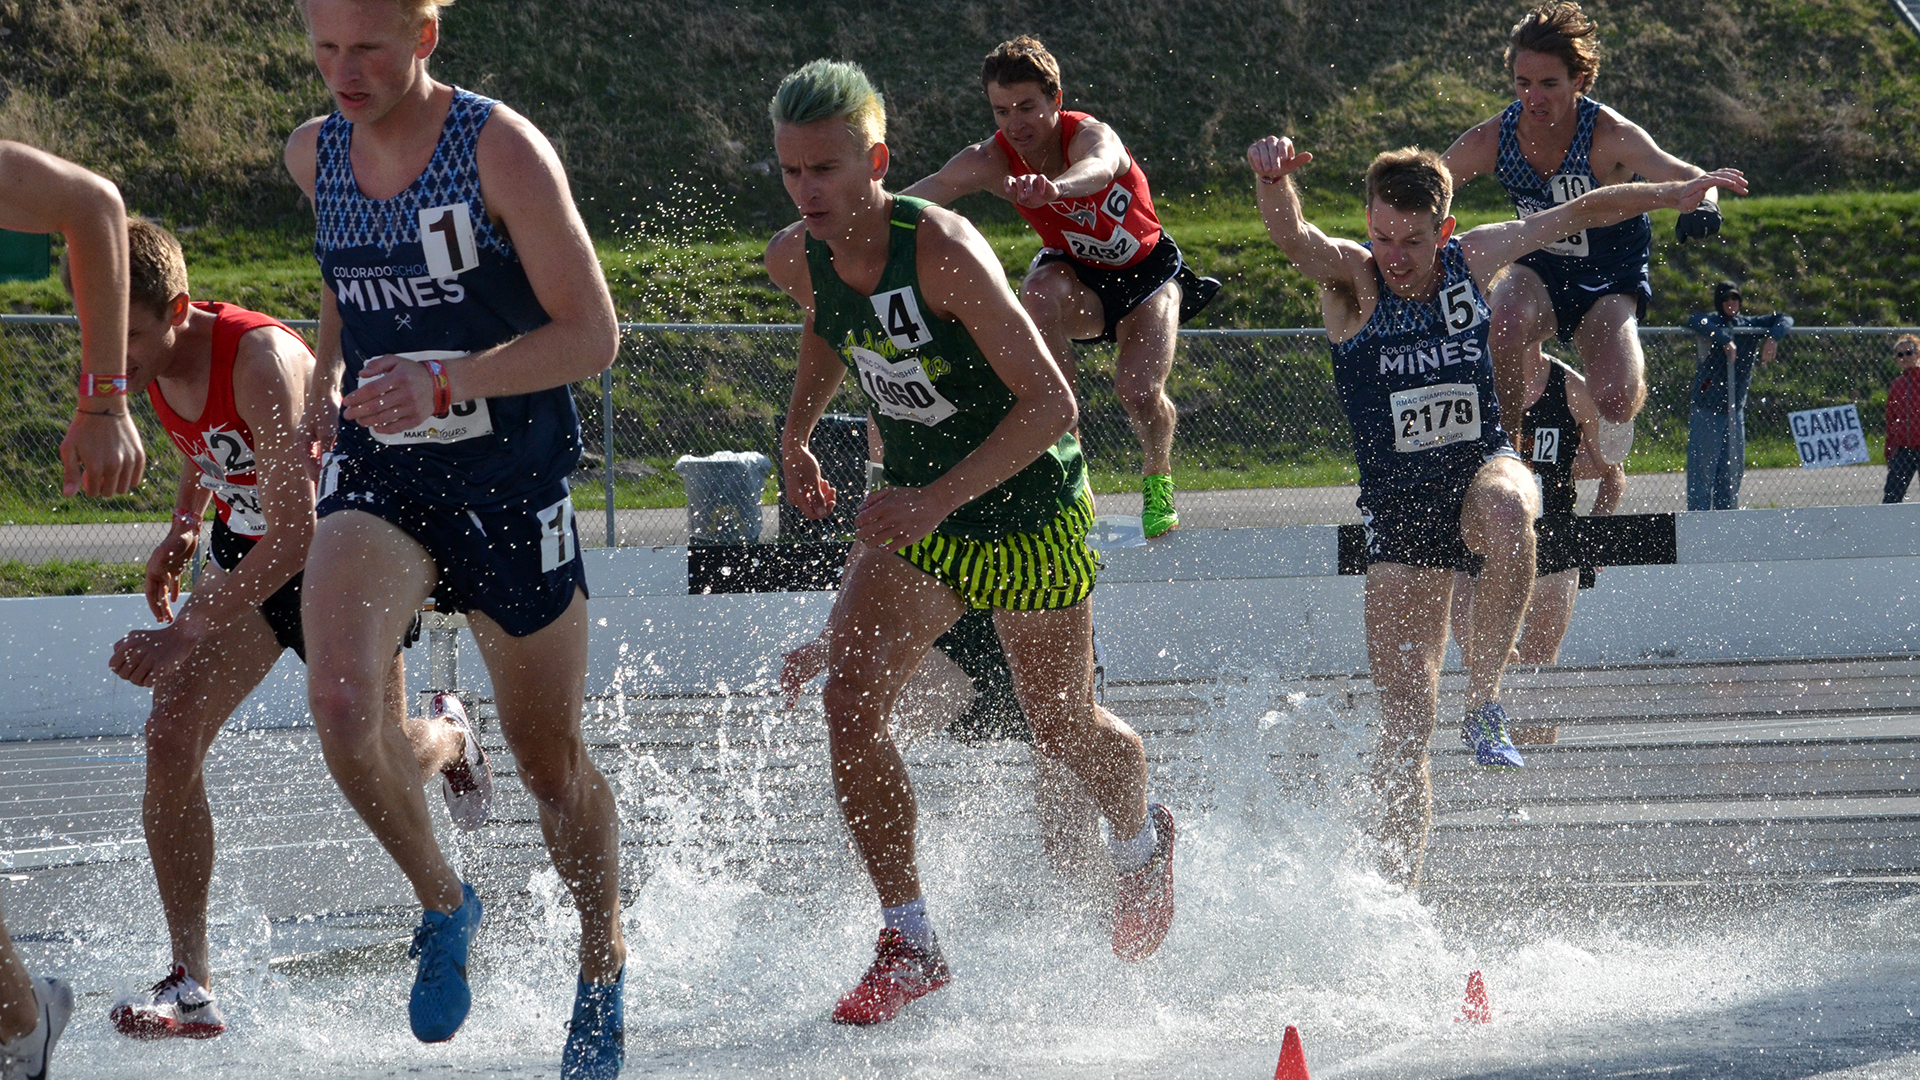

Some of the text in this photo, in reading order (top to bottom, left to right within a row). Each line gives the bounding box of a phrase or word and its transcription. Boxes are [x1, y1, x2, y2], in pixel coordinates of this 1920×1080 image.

[1107, 190, 1129, 217] 6
[1558, 176, 1586, 201] 10
[429, 210, 464, 272] 1
[335, 274, 465, 312] MINES
[1446, 285, 1474, 330] 5
[888, 292, 920, 344] 4
[1380, 338, 1482, 375] MINES
[864, 370, 936, 409] 1960
[1395, 390, 1474, 407] RMAC CHAMPIONSHIP
[403, 426, 467, 440] MAKE YOURS
[1400, 398, 1473, 438] 2179
[1792, 408, 1858, 437] GAME
[210, 434, 256, 472] 2
[1537, 430, 1555, 460] 12
[1799, 438, 1841, 463] DAY
[548, 504, 566, 563] 1
